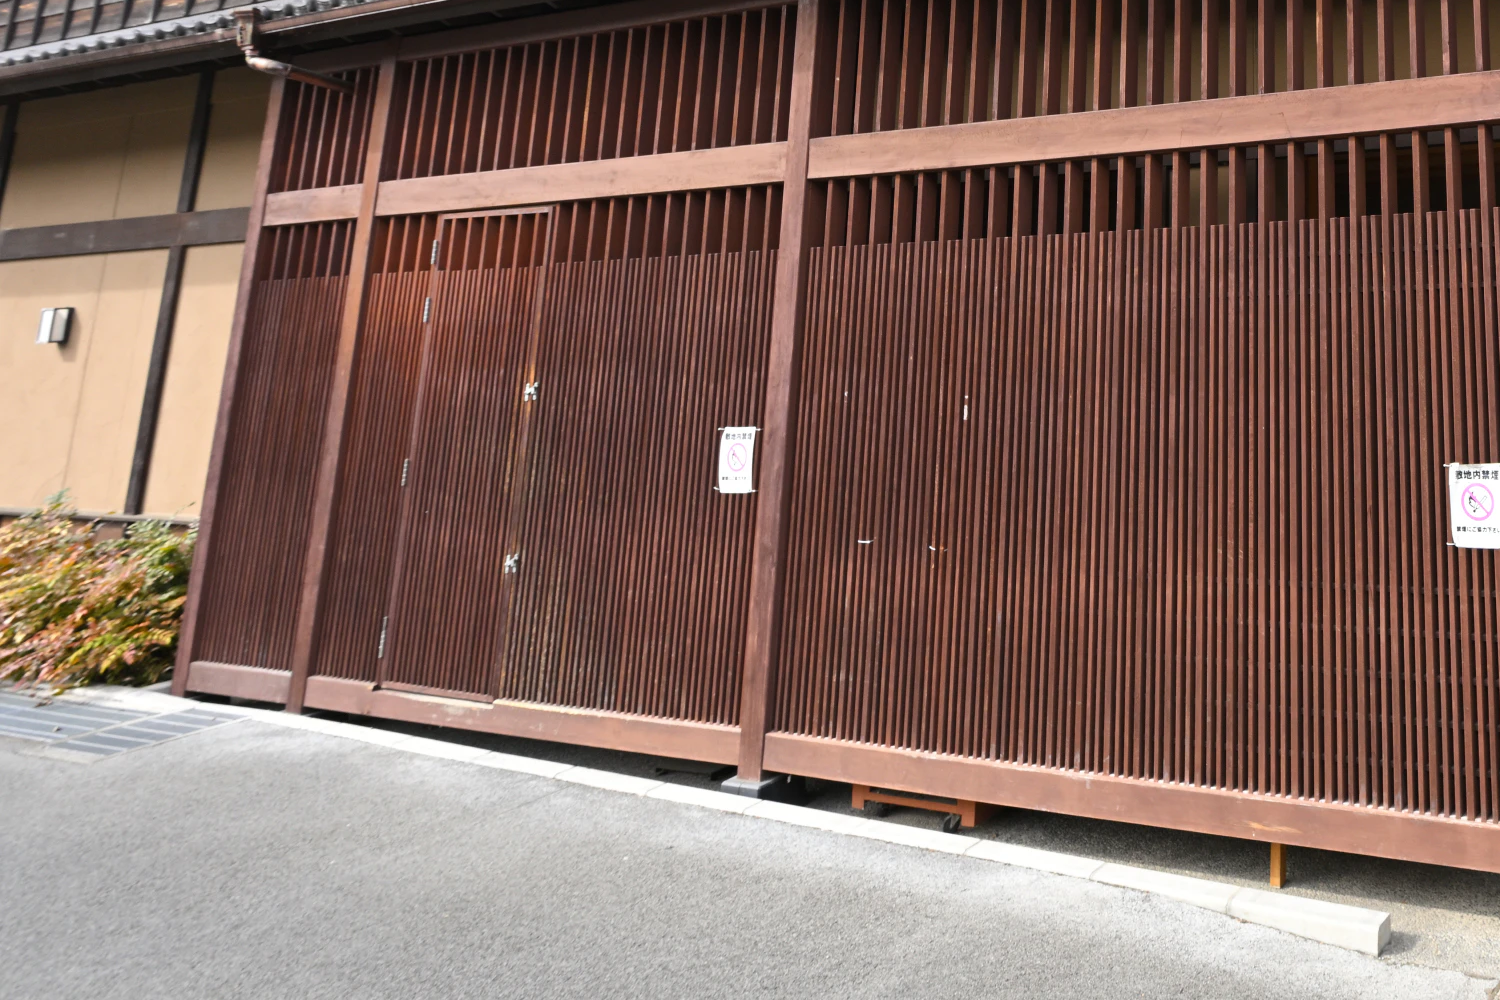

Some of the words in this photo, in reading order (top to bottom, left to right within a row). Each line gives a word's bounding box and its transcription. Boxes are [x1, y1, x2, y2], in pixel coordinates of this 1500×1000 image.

[1455, 469, 1499, 480] 敷地内禁煙
